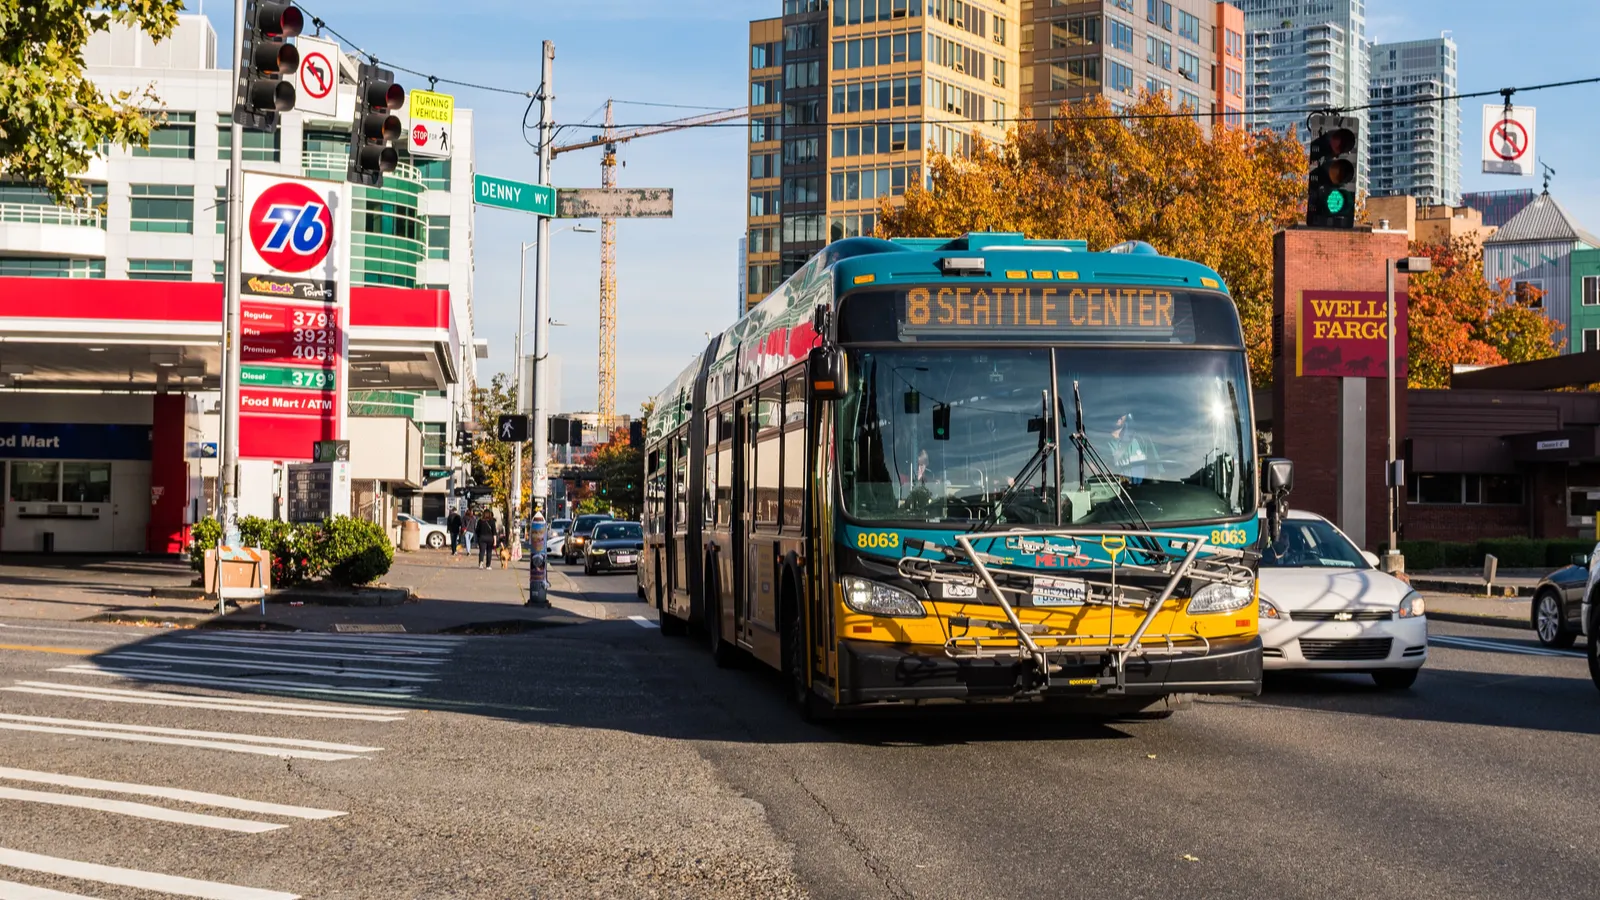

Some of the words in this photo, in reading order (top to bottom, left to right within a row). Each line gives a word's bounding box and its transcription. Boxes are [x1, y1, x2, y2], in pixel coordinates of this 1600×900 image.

[416, 95, 449, 109] TURNING
[416, 108, 448, 121] VEHICLES
[413, 130, 428, 140] STOP
[481, 180, 522, 203] DENNY
[534, 192, 549, 206] WY
[260, 200, 327, 256] 76
[293, 282, 332, 298] Points
[908, 287, 931, 325] 8
[937, 287, 1058, 326] SEATTLE
[1069, 288, 1173, 327] CENTER
[243, 310, 273, 320] Regular
[293, 311, 328, 328] 379
[243, 328, 260, 336] Plus
[293, 328, 327, 344] 392
[1313, 321, 1397, 340] FARGO
[243, 345, 276, 355] Premium
[292, 345, 327, 361] 405
[241, 372, 266, 381] Diesel
[291, 371, 327, 388] 379
[241, 396, 269, 407] Food
[272, 397, 299, 409] Mart
[307, 399, 332, 410] ATM
[21, 435, 60, 448] Mart
[857, 532, 899, 548] 8063
[1211, 529, 1247, 545] 8063
[1035, 554, 1090, 567] METRO
